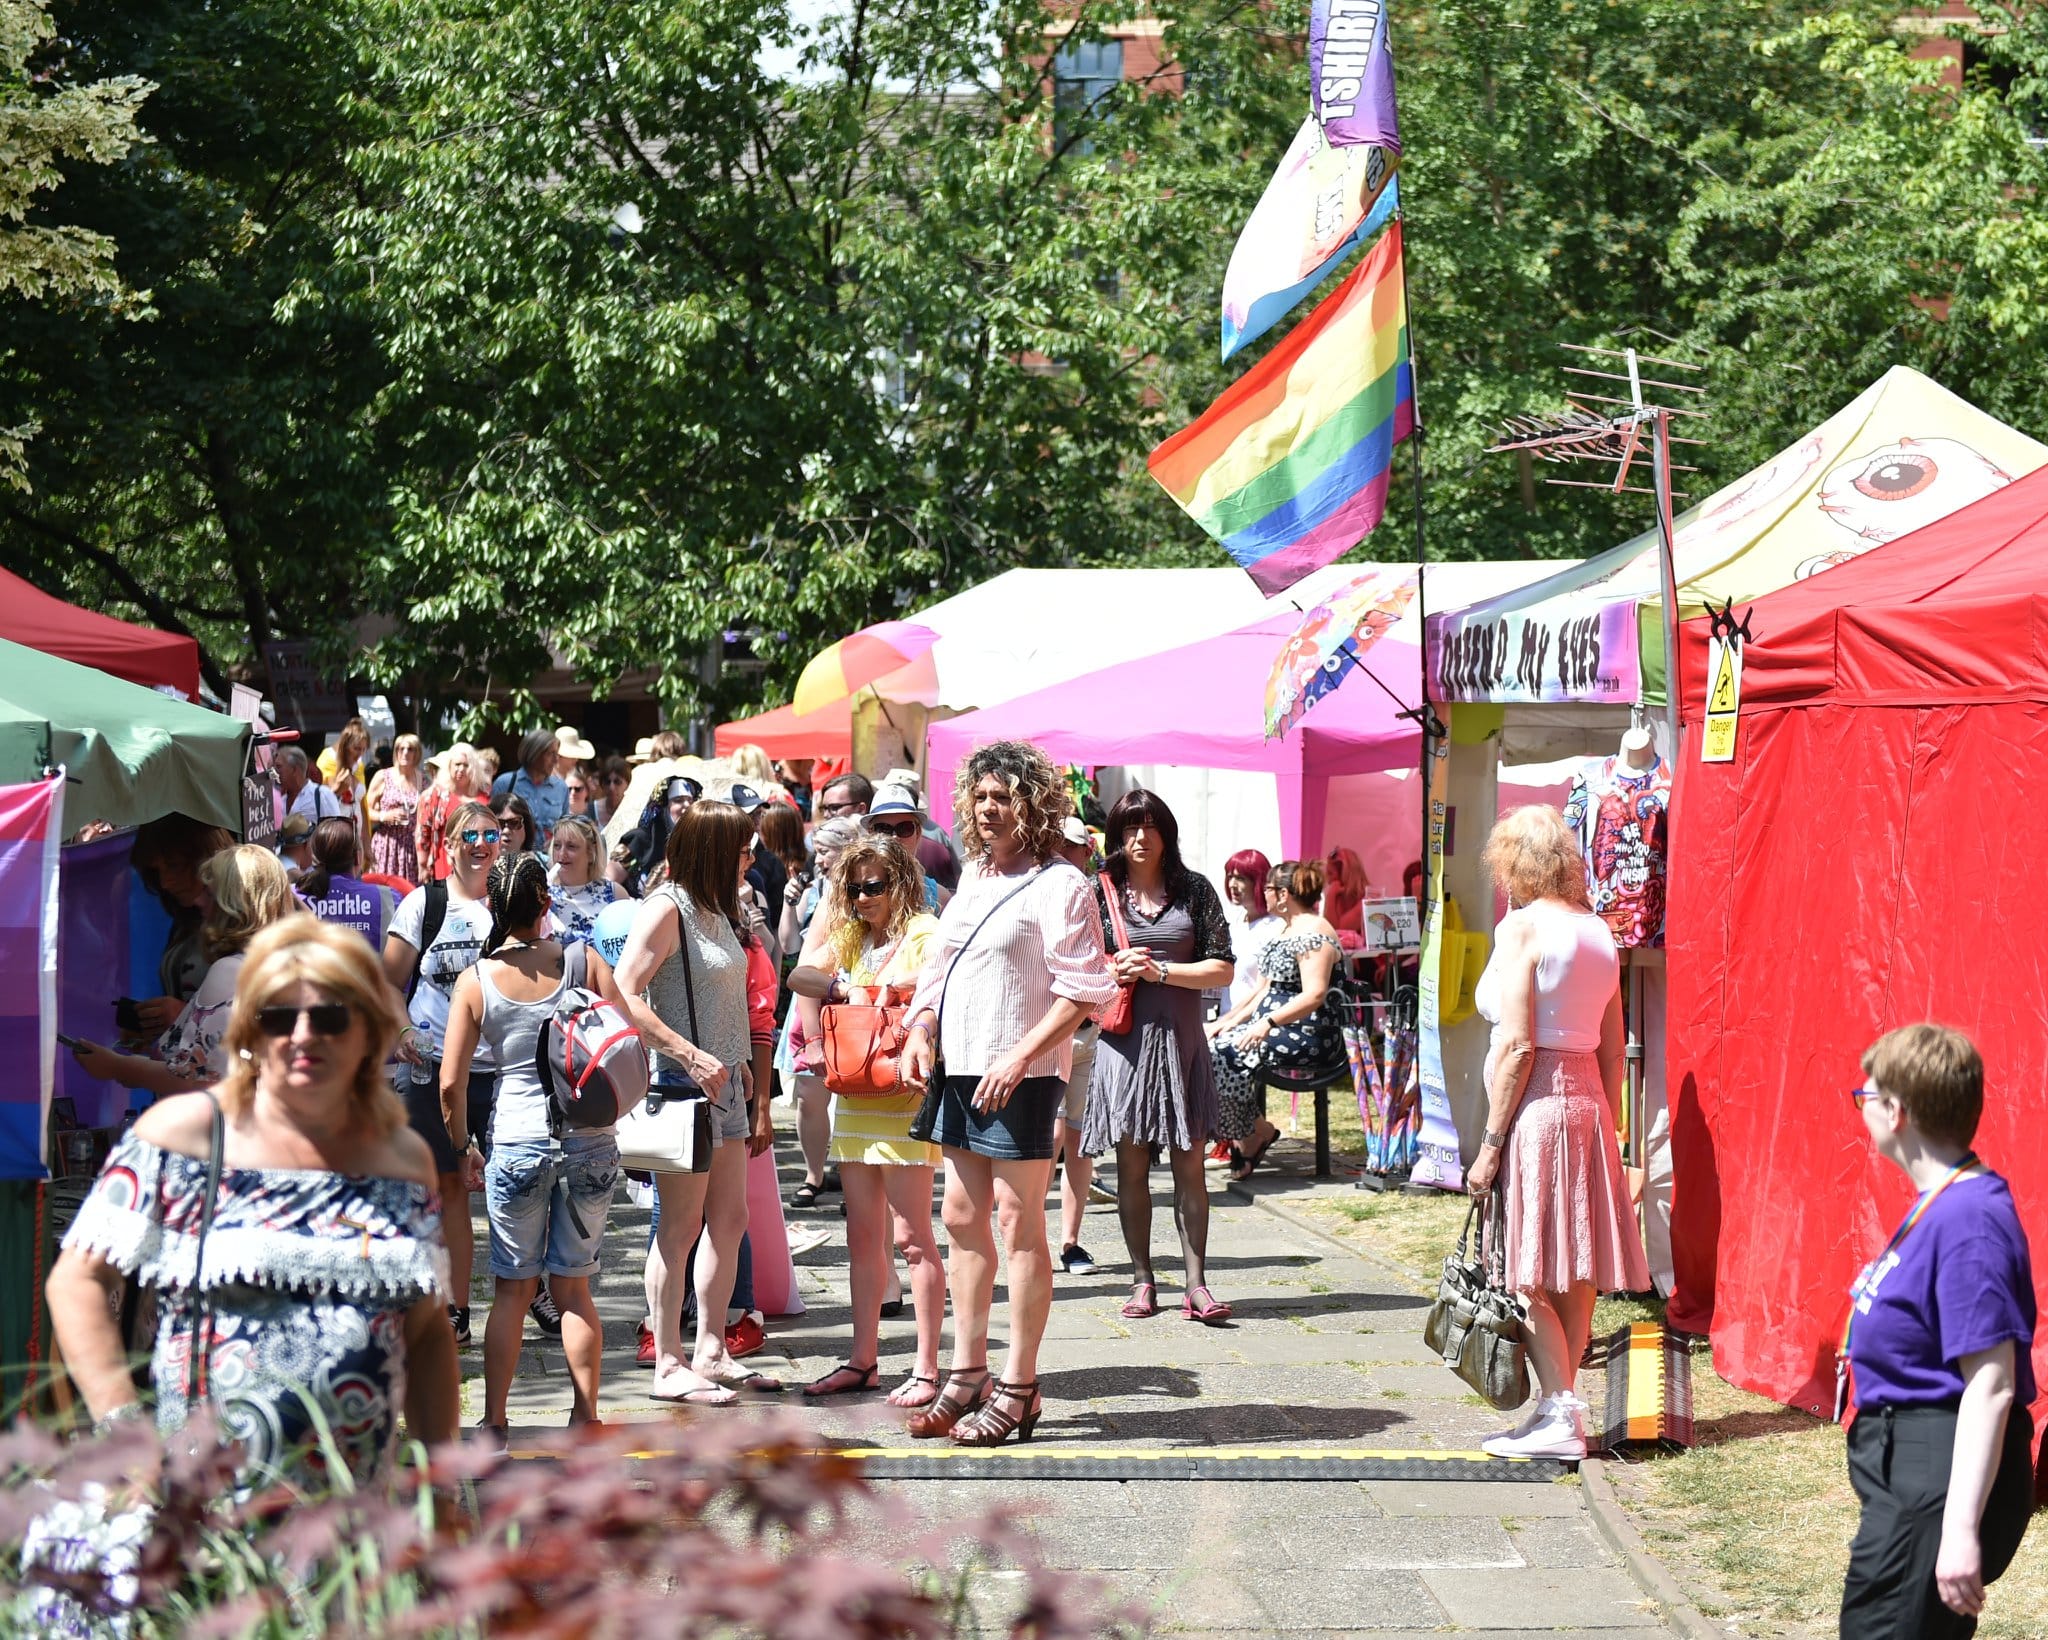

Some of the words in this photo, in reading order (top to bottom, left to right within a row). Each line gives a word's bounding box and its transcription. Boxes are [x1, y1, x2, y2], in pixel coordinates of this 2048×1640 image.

[1516, 617, 1550, 699] MY
[1557, 612, 1601, 697] EYES
[1710, 719, 1732, 736] Danger
[248, 798, 270, 823] best
[306, 893, 371, 921] Sparkle
[1396, 918, 1412, 929] £20
[602, 934, 628, 949] OFFEN
[1441, 1148, 1455, 1163] to
